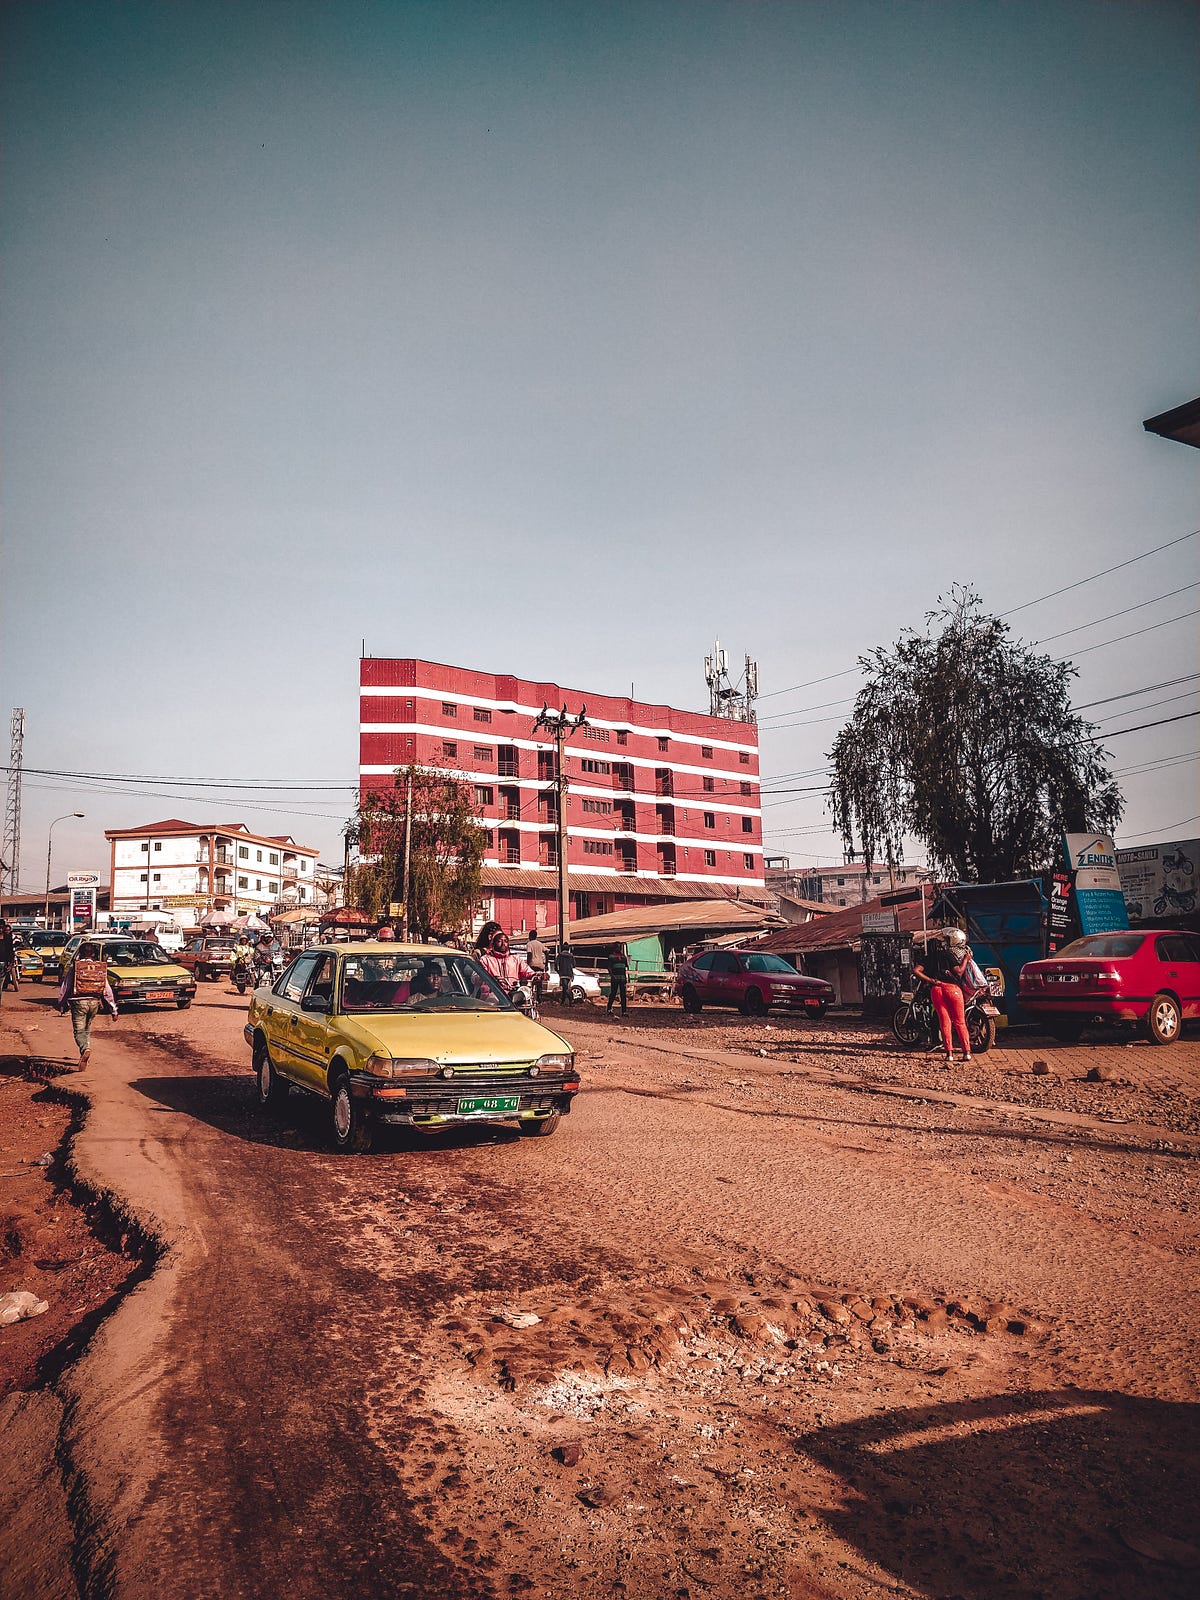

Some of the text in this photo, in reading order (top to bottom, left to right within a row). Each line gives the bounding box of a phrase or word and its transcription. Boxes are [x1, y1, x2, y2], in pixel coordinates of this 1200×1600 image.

[1076, 853, 1114, 867] ZENITHE
[1053, 873, 1068, 881] HERE
[1051, 897, 1067, 905] Orange
[1051, 904, 1067, 912] Money
[460, 1099, 517, 1110] 06 68 76
